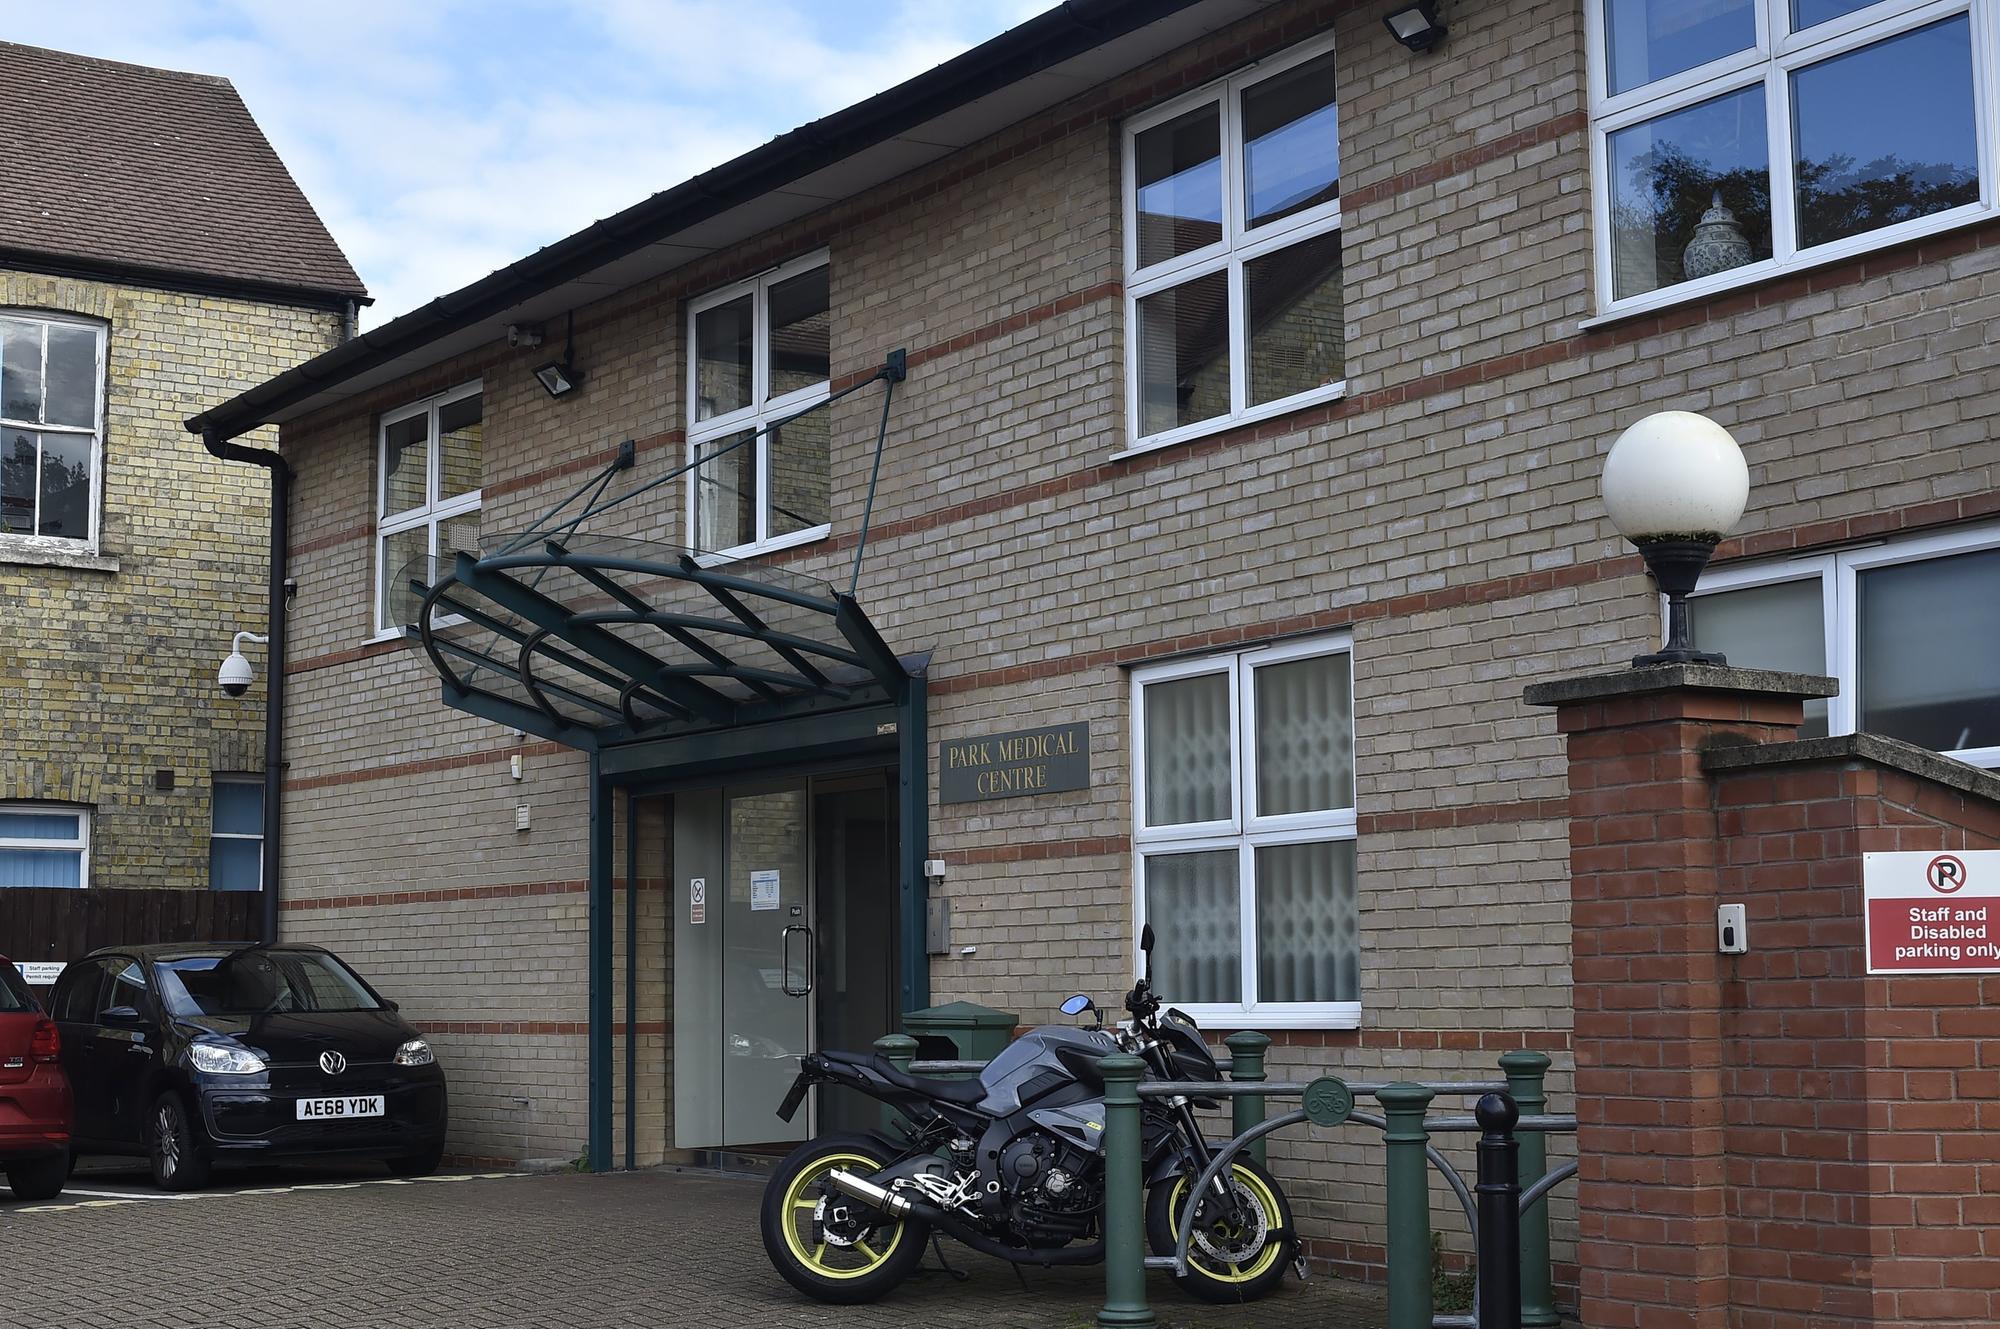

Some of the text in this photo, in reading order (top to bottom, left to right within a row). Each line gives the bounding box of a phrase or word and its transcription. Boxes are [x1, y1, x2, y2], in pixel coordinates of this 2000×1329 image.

[949, 731, 1079, 769] PARK MEDICAL
[977, 764, 1047, 794] CENTRE
[1909, 906, 1986, 922] Staff and
[1911, 925, 1986, 940] Disabled
[1895, 942, 2000, 961] parking only
[304, 1098, 377, 1116] AE68 YDK
